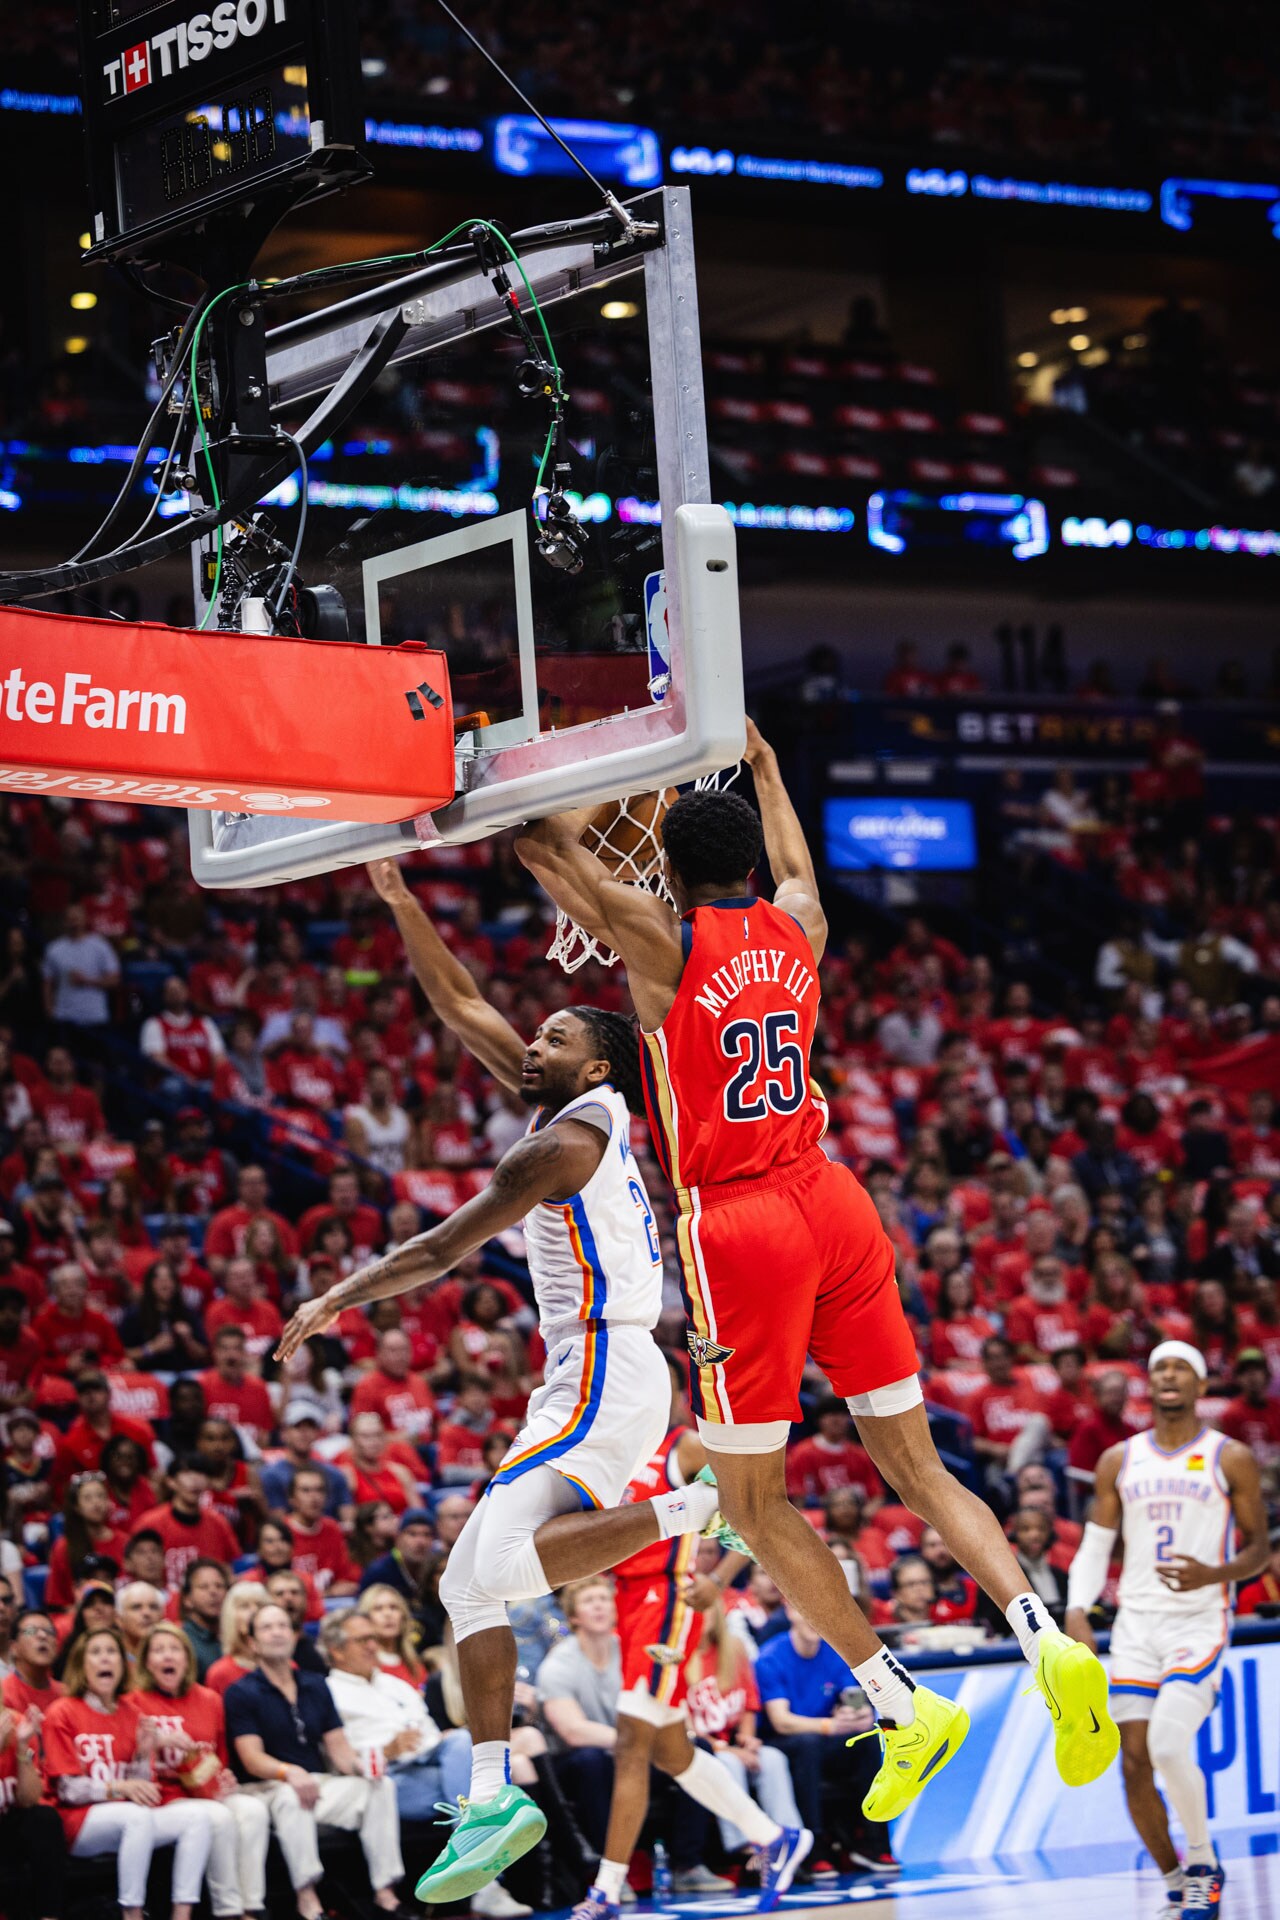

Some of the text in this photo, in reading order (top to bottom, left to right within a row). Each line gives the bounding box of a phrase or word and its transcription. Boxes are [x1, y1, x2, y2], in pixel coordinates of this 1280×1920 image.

[0, 668, 187, 735] teFarm
[0, 769, 241, 805] StateFa
[694, 949, 815, 1019] MURPHY III
[720, 1010, 807, 1122] 25
[1125, 1478, 1212, 1503] OKLAHOMA
[1147, 1502, 1183, 1521] CITY
[1156, 1525, 1174, 1563] 2
[74, 1733, 115, 1763] GET
